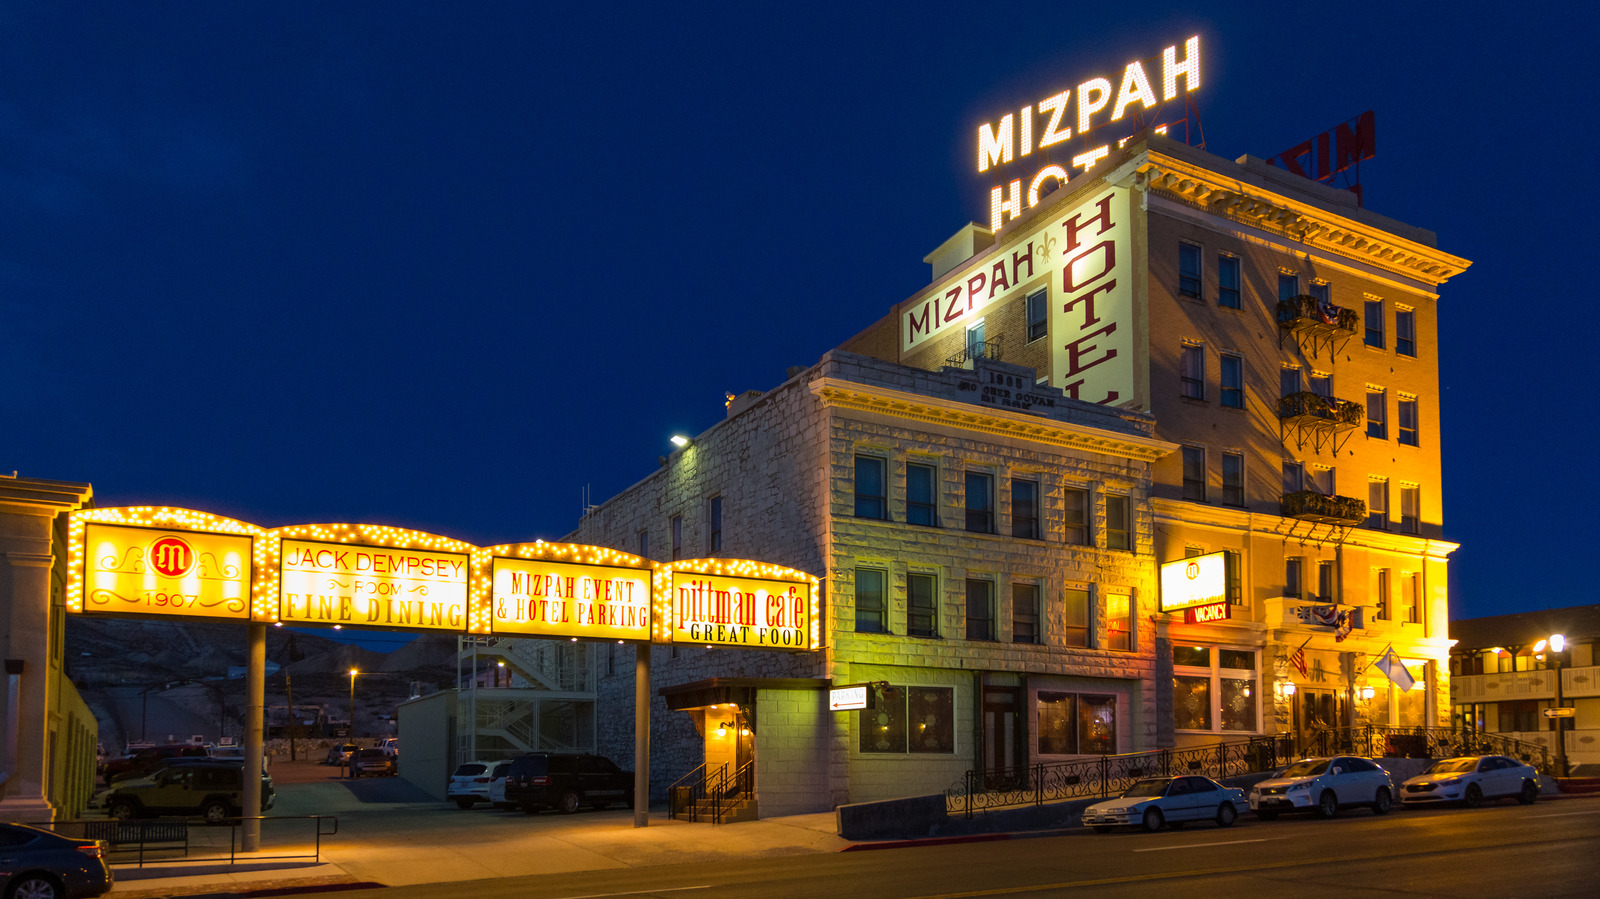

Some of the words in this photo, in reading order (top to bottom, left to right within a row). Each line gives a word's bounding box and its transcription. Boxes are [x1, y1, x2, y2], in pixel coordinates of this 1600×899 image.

[978, 35, 1200, 173] MIZPAH
[908, 241, 1034, 344] MIZPAH
[1062, 192, 1119, 404] HOTEL
[287, 548, 349, 570] JACK
[356, 552, 463, 578] DEMPSEY
[145, 592, 198, 609] 1907
[354, 580, 402, 596] ROOM
[512, 572, 575, 598] MIZPAH
[583, 578, 635, 603] EVENT
[286, 593, 352, 621] FINE
[366, 598, 462, 627] DINING
[497, 597, 507, 619] &
[516, 598, 569, 623] HOTEL
[577, 602, 647, 627] PARKING
[678, 580, 757, 629] pittman
[766, 586, 803, 629] cafe
[1194, 603, 1227, 622] VACANCY
[691, 623, 749, 643] GREAT
[759, 628, 803, 646] FOOD
[832, 688, 864, 700] PARKING
